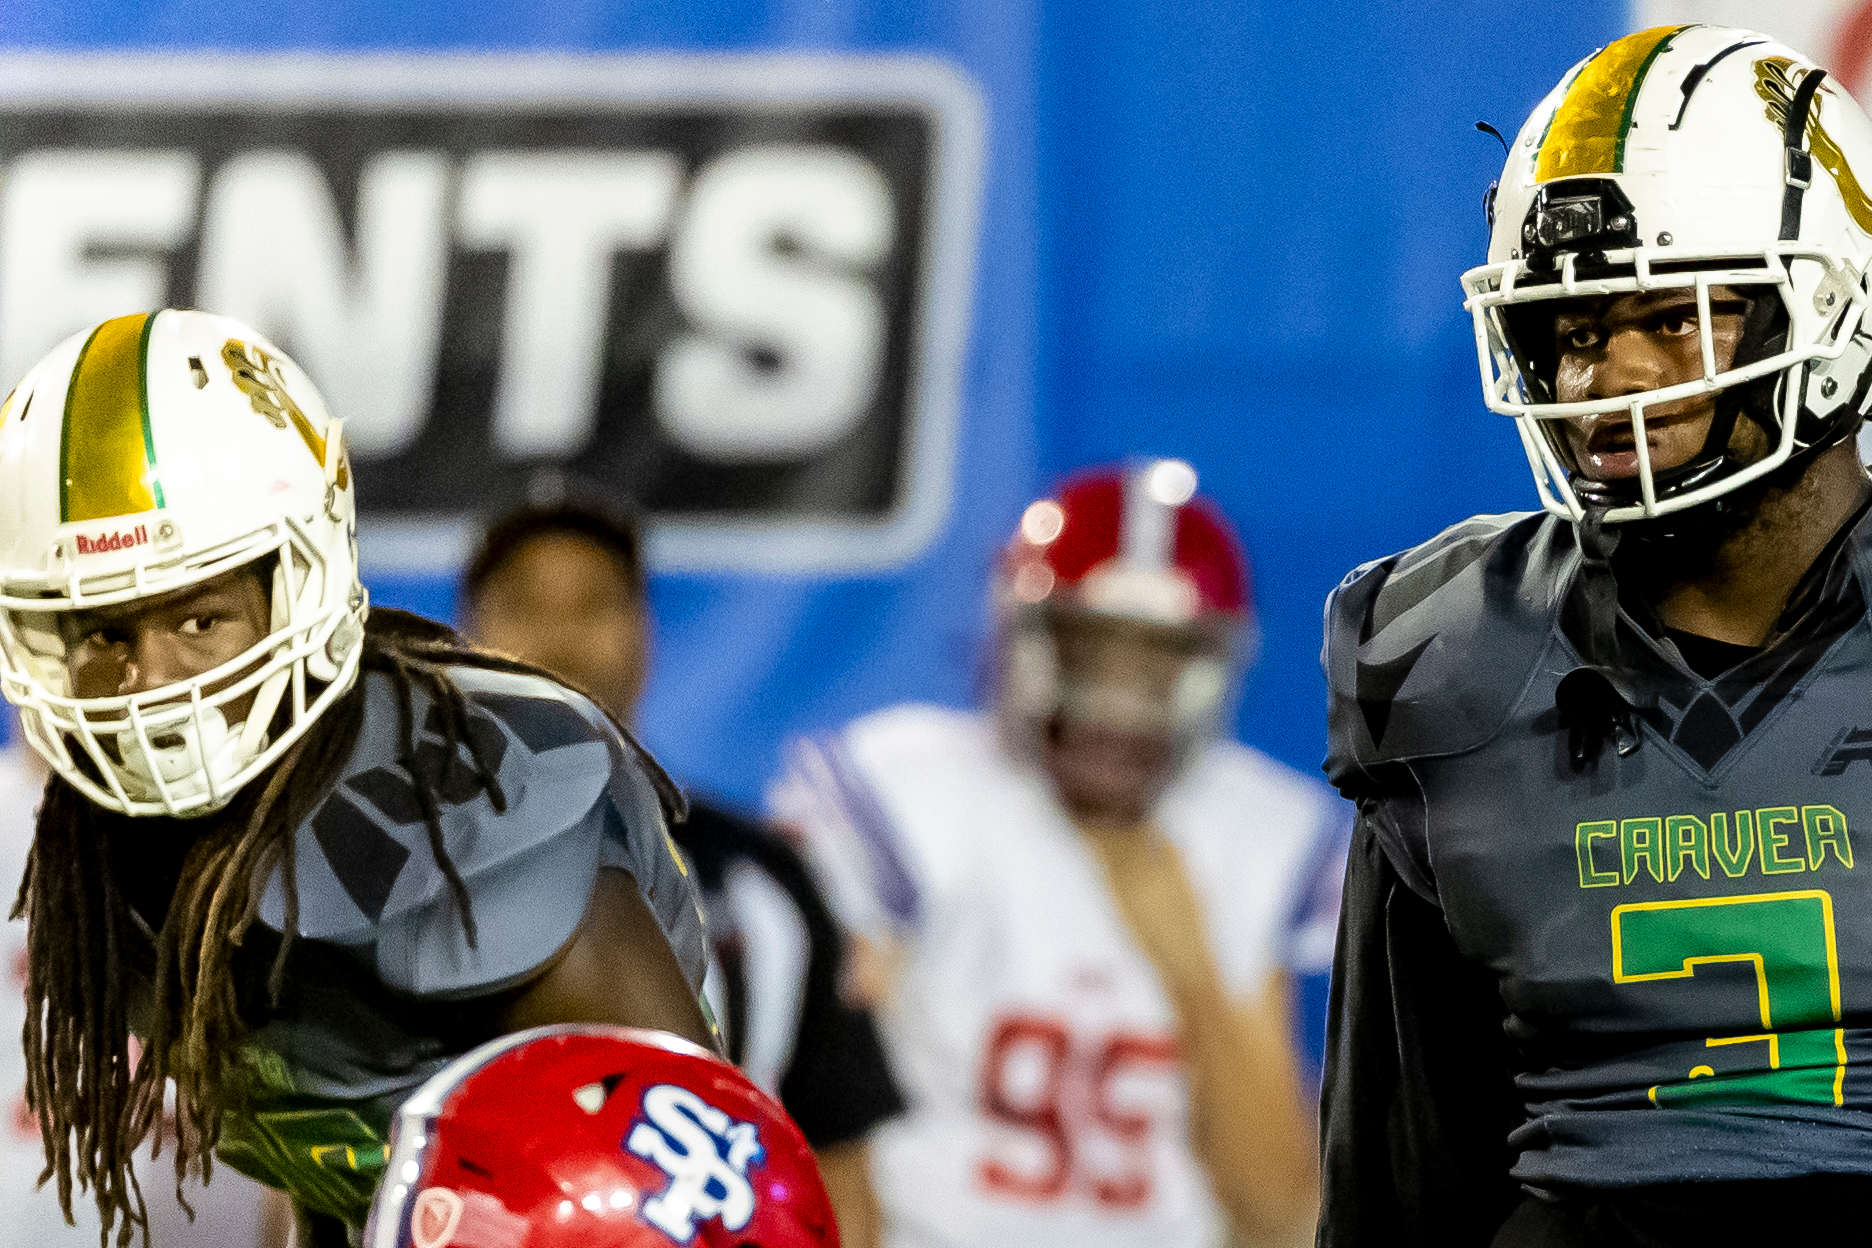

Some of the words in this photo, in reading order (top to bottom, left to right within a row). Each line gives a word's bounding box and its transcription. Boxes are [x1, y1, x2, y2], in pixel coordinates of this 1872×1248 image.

[76, 524, 148, 554] Riddell
[1575, 804, 1854, 889] CARVER
[972, 1015, 1185, 1208] 95
